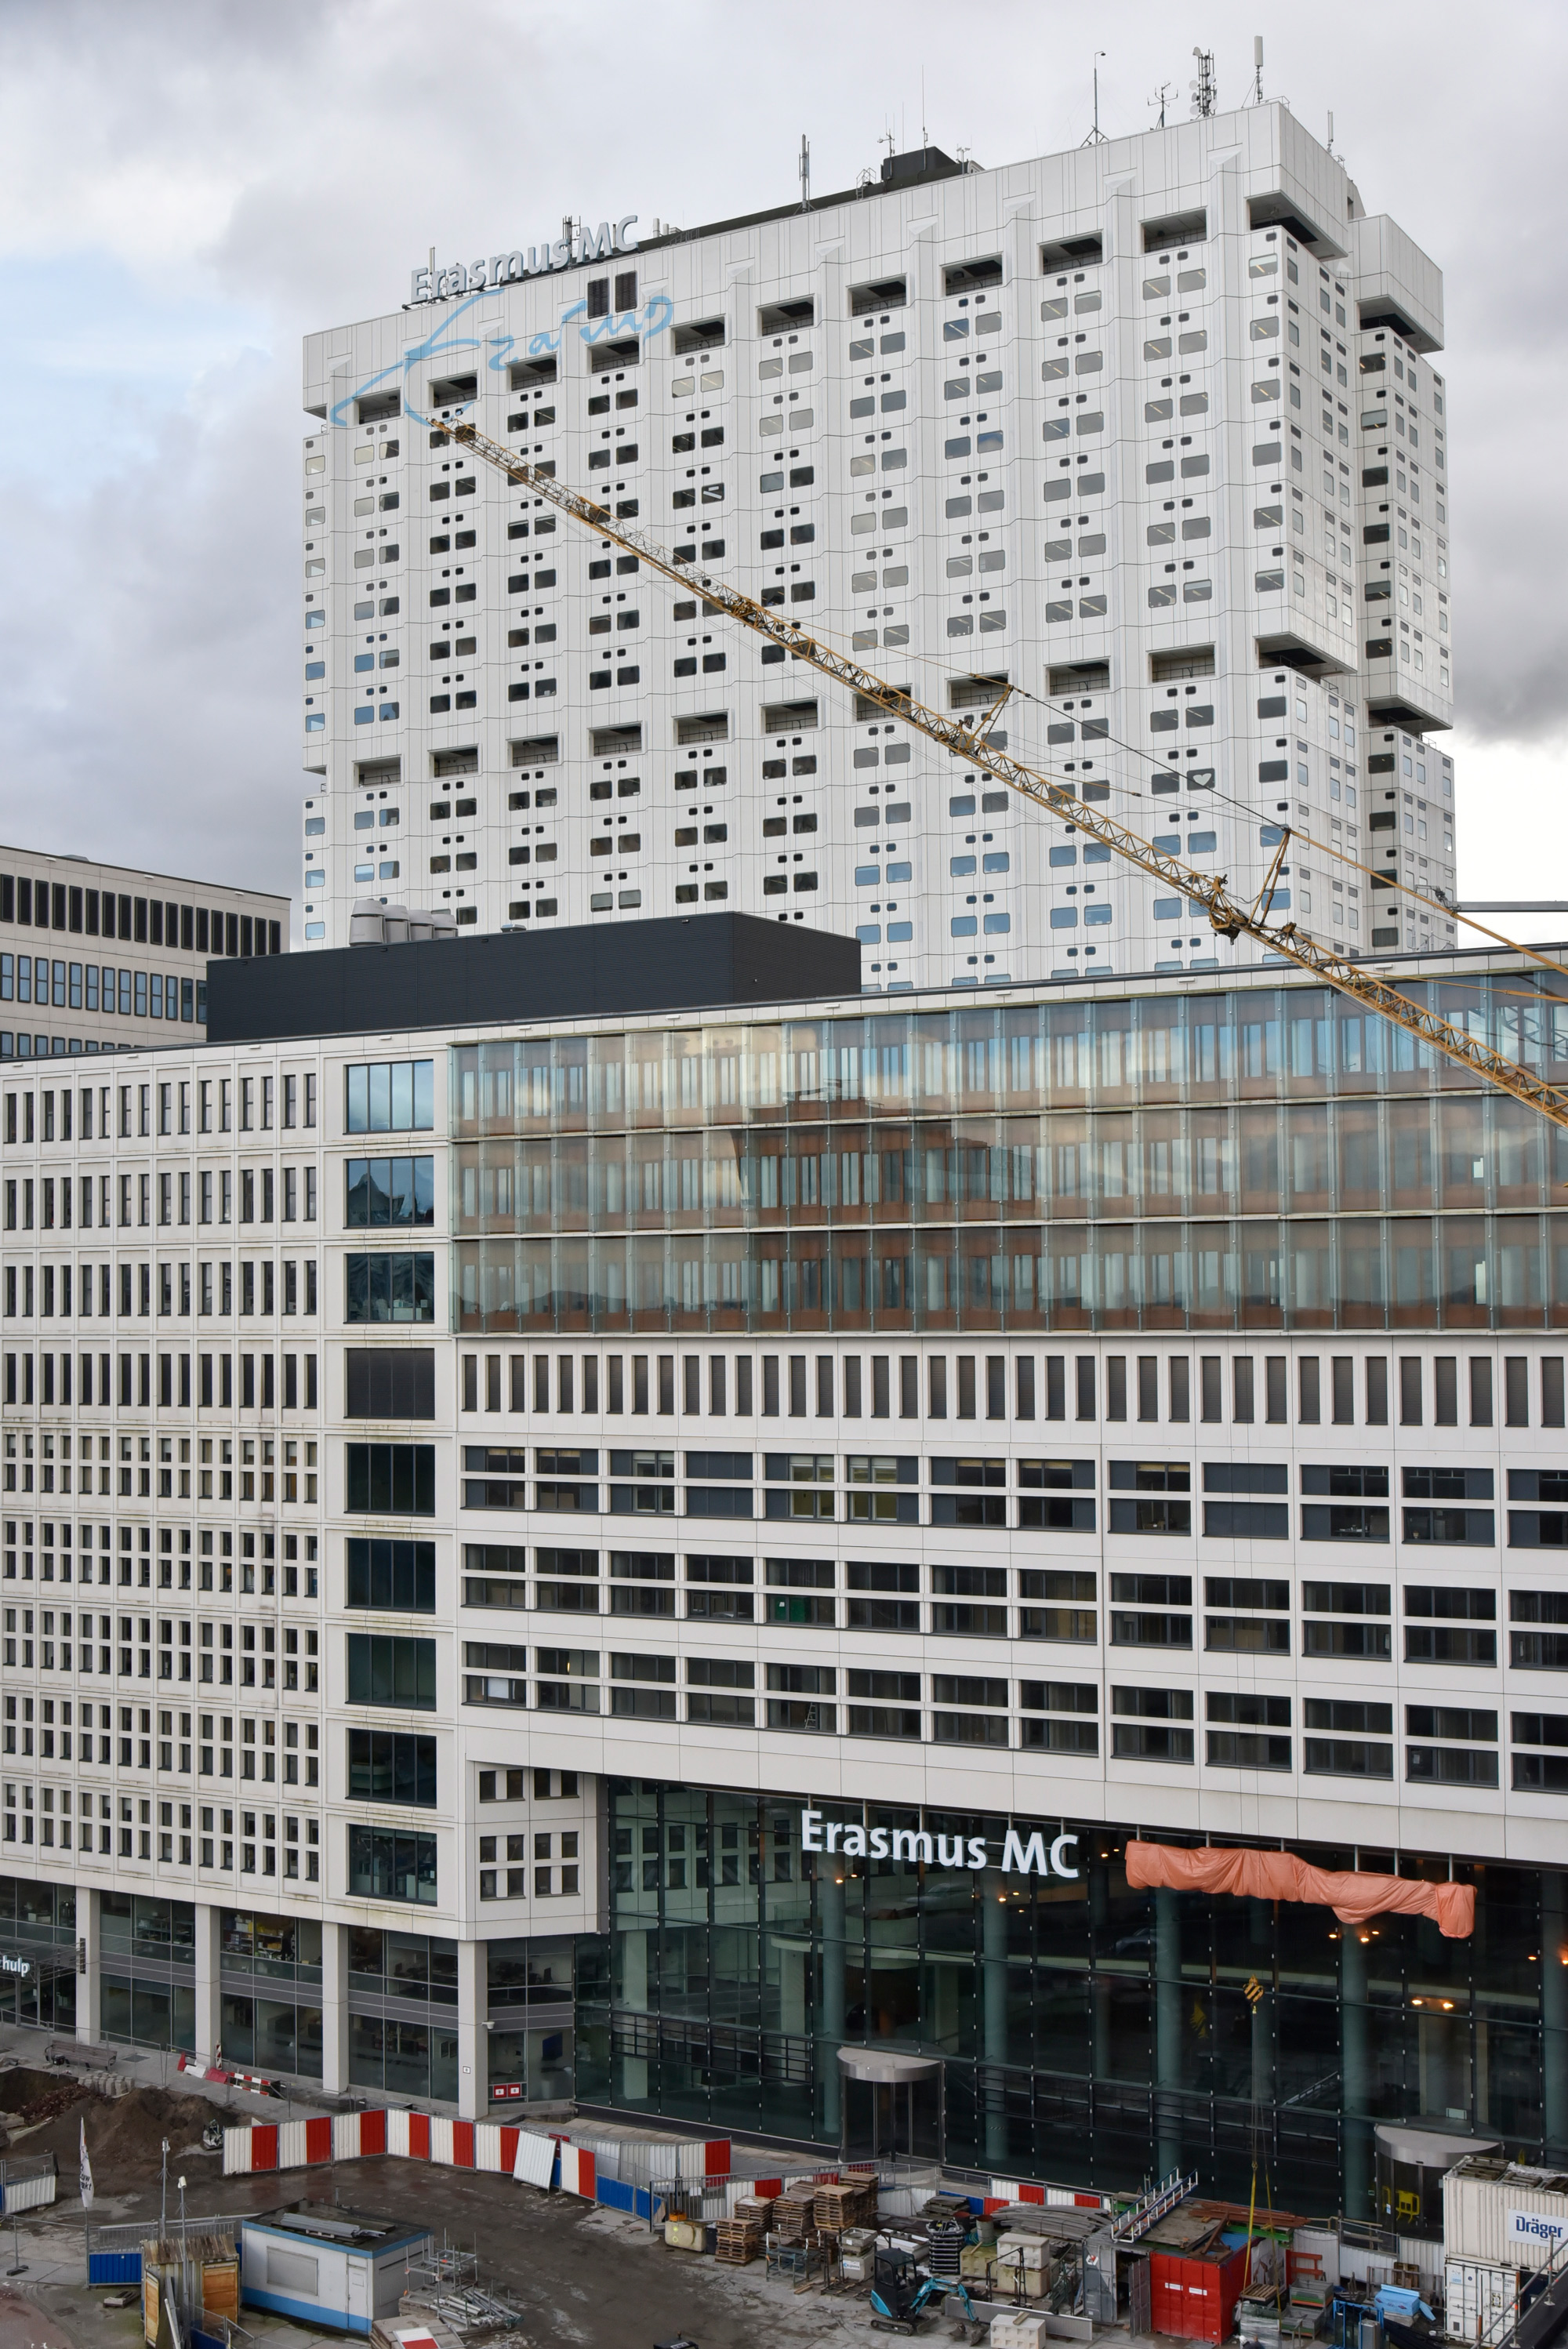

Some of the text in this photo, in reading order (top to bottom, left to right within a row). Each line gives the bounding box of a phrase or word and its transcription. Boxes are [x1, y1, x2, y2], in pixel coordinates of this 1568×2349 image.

[411, 215, 639, 305] Erasmus MC
[801, 1810, 1080, 1879] Erasmus MC
[1516, 2216, 1563, 2238] Dräger
